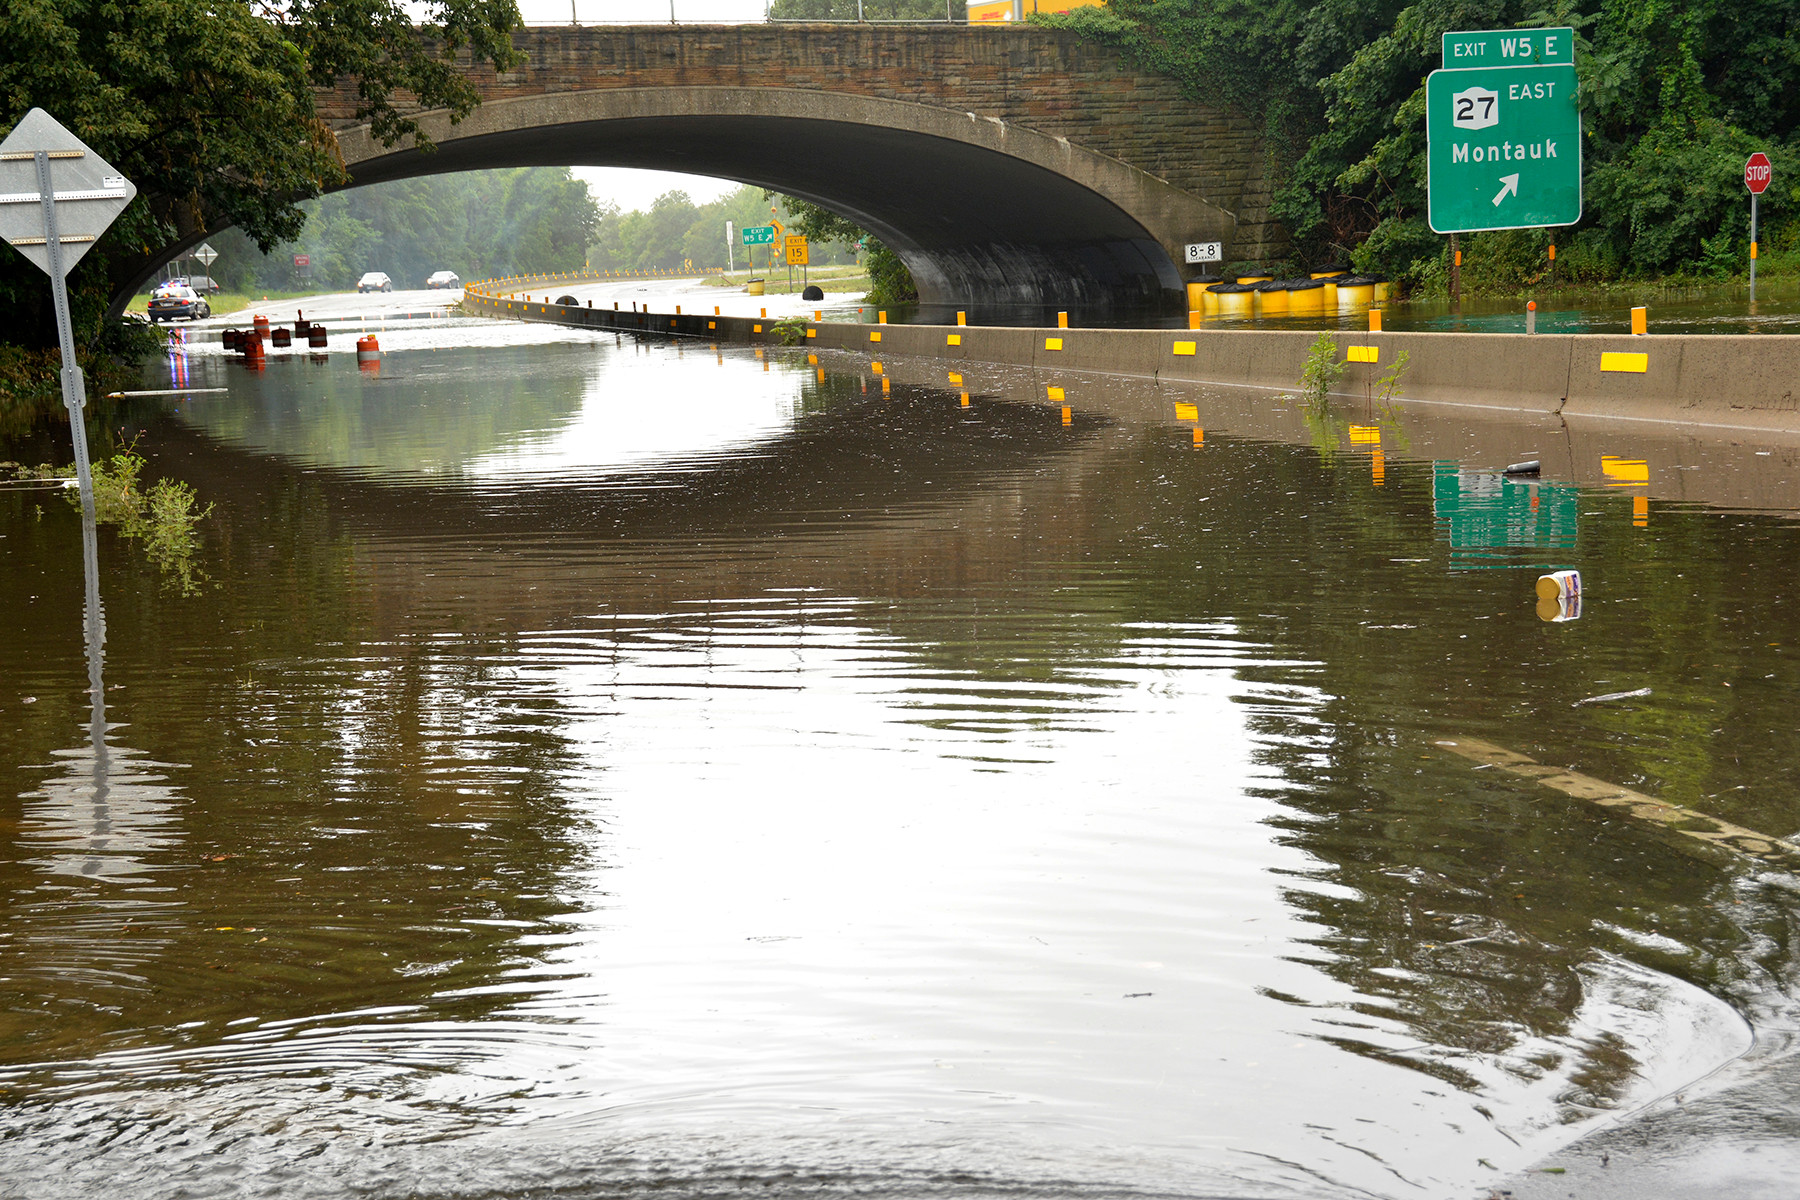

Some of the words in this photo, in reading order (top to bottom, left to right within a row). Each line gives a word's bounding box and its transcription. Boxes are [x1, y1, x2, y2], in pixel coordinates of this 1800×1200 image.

[1454, 42, 1487, 57] EXIT
[1500, 37, 1532, 58] W5
[1545, 36, 1558, 56] E
[1509, 82, 1556, 100] EAST
[1456, 97, 1495, 121] 27
[1452, 138, 1558, 164] Montauk
[1747, 165, 1769, 181] STOP
[792, 248, 802, 257] 15
